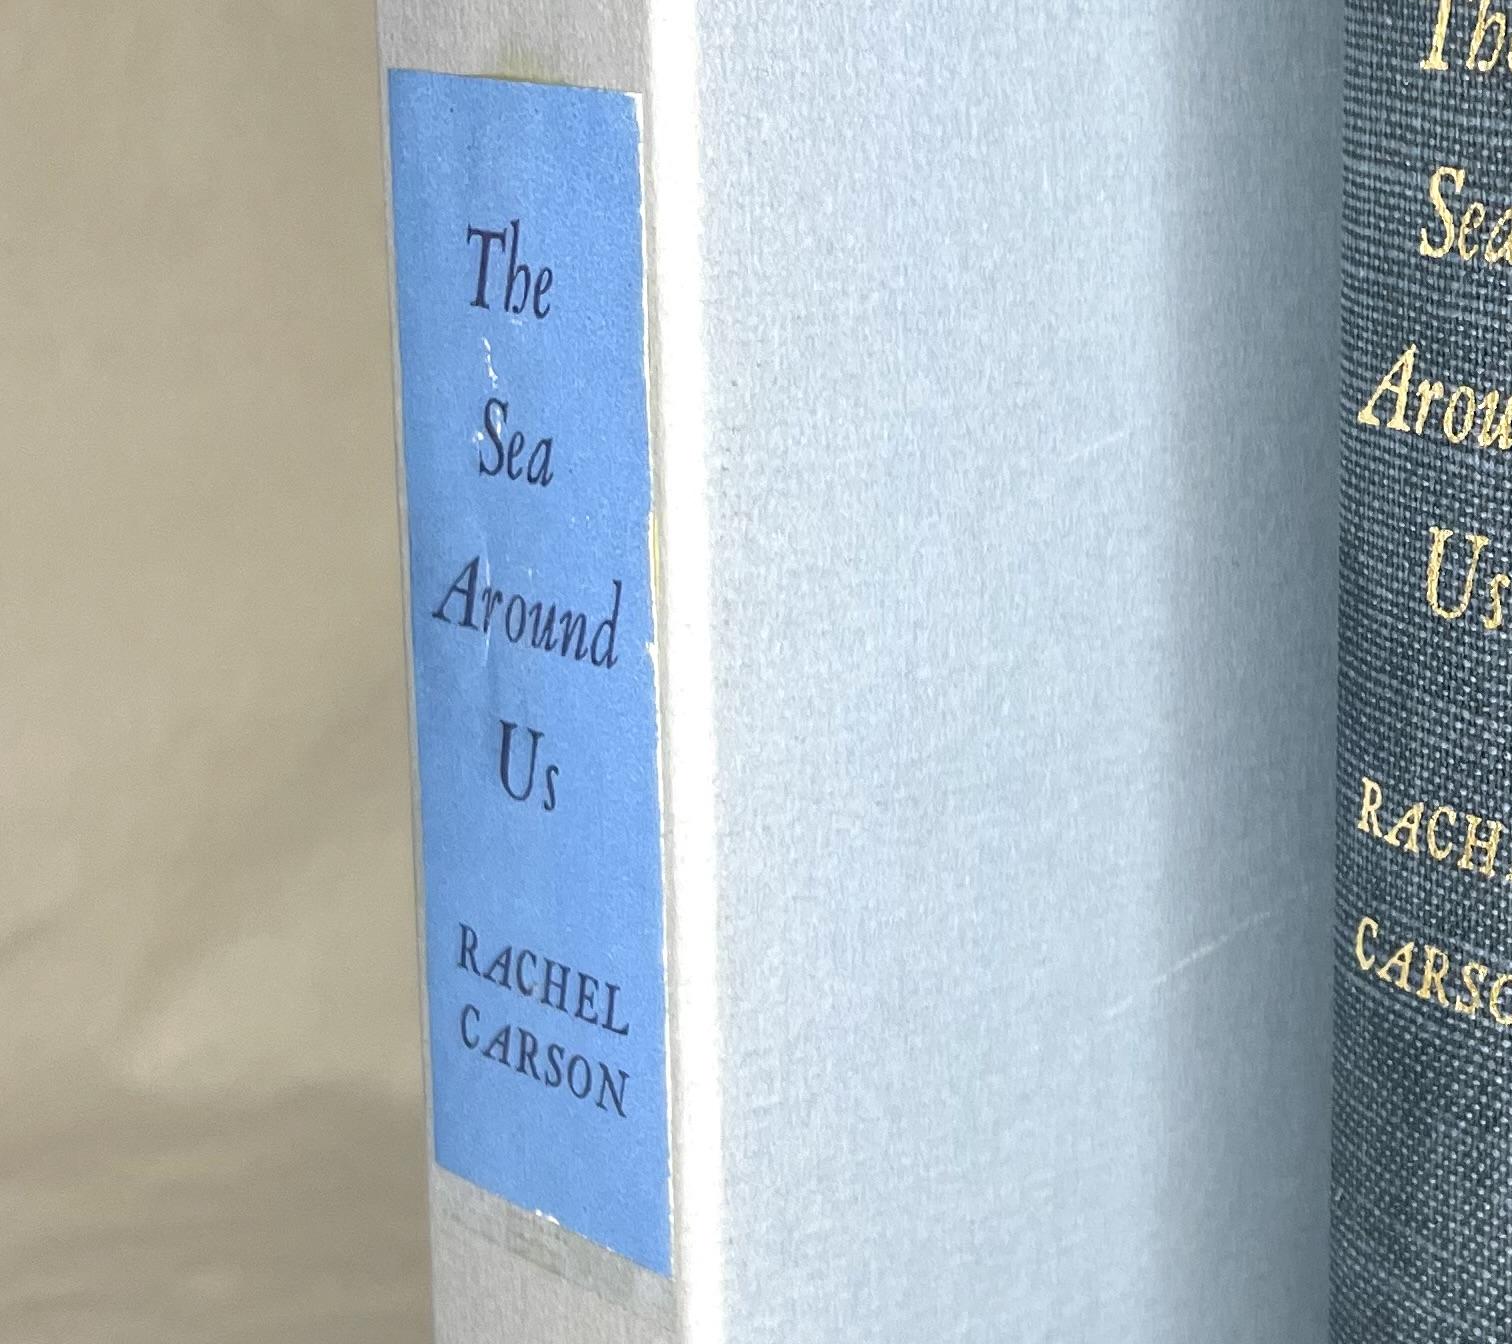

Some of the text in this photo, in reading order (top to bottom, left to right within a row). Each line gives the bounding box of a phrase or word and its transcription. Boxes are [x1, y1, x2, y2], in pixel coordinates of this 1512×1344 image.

[466, 219, 554, 320] The
[479, 398, 555, 488] Sea
[431, 554, 623, 670] Around
[1425, 525, 1511, 630] Us
[499, 719, 560, 812] Us
[457, 922, 630, 1037] RACHEL
[459, 1003, 630, 1119] CARSON
